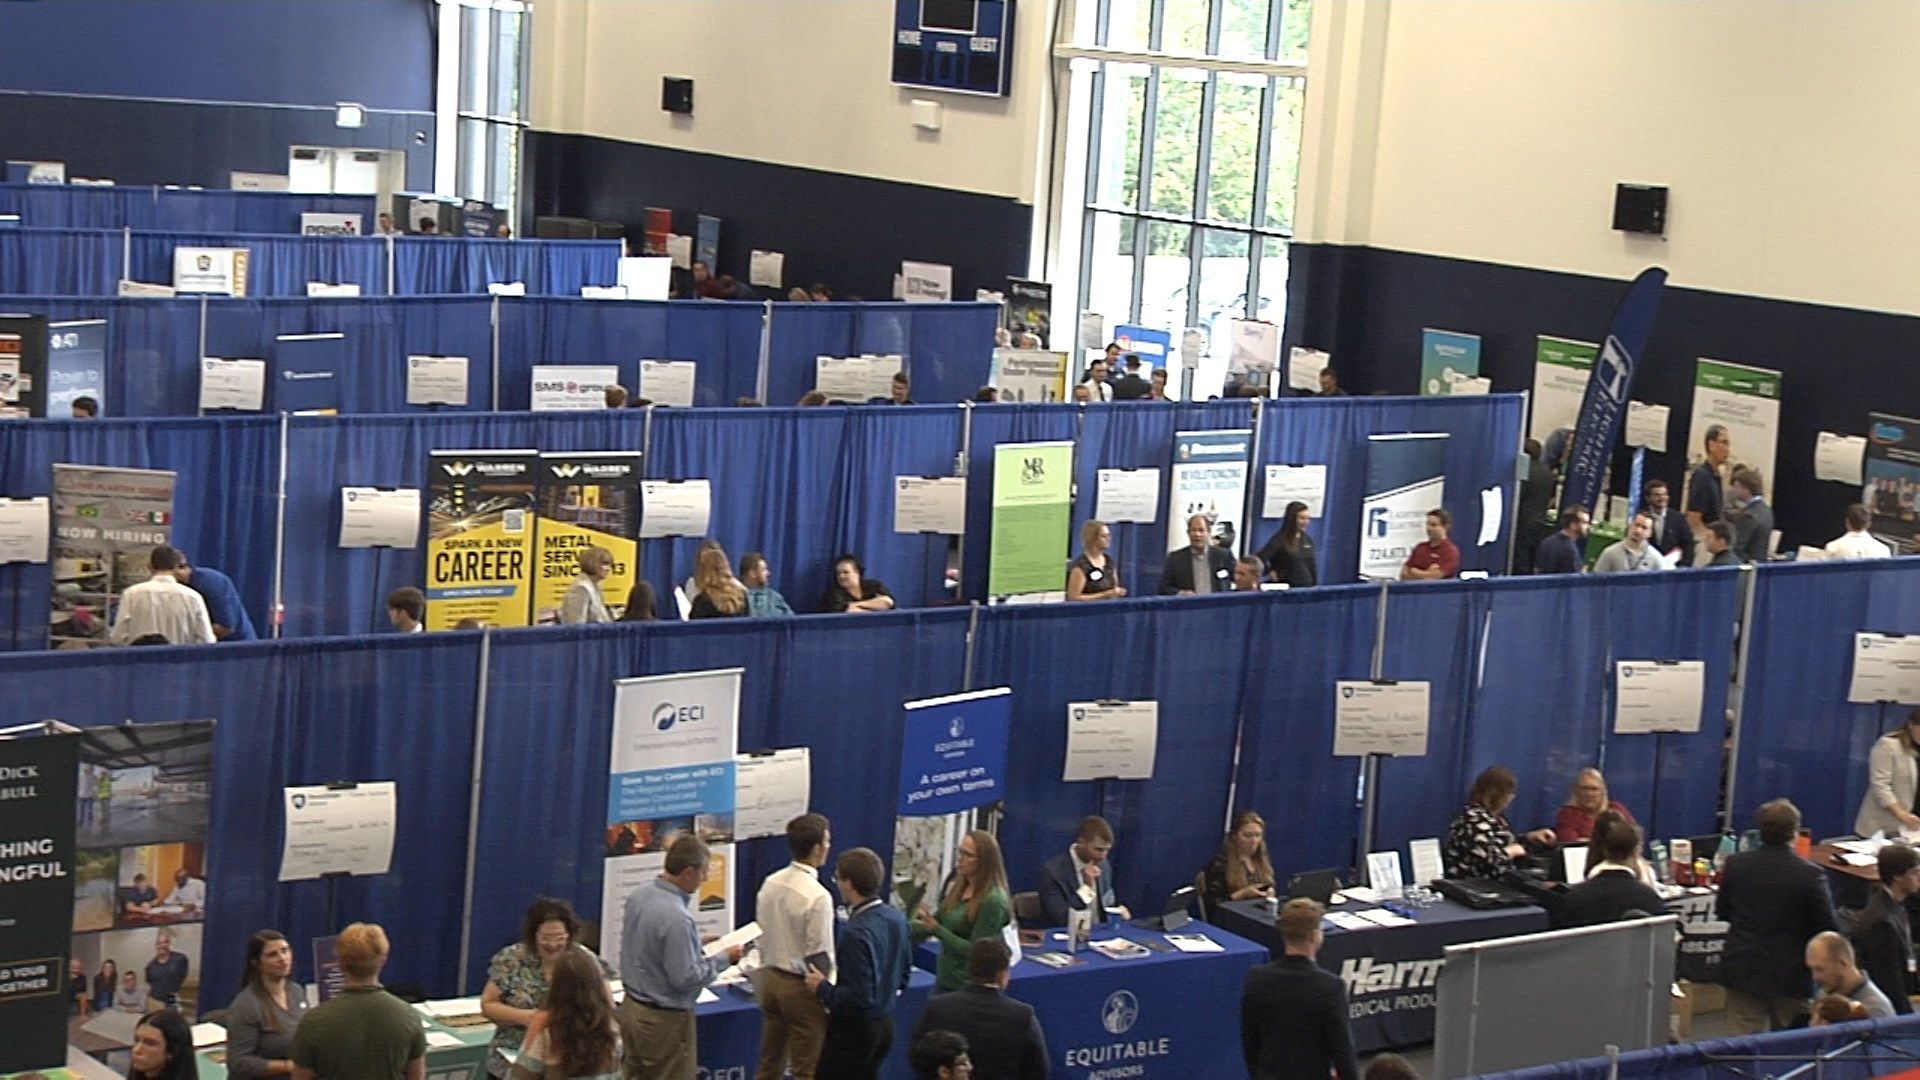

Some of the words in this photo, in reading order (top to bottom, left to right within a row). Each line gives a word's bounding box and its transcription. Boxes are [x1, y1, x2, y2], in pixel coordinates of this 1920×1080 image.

[535, 381, 564, 392] SMS
[57, 527, 98, 540] NOW
[102, 528, 166, 545] HIRING
[444, 540, 481, 551] SPARK
[485, 540, 494, 549] A
[496, 539, 524, 549] NEW
[544, 535, 594, 549] METAL
[434, 550, 524, 583] CAREER
[543, 551, 581, 565] SERV
[542, 564, 581, 579] SINC
[678, 705, 706, 723] ECI
[920, 773, 931, 785] A
[931, 770, 969, 783] career
[969, 767, 986, 777] on
[0, 786, 36, 799] BULL
[906, 789, 935, 805] your
[935, 784, 961, 796] own
[962, 779, 996, 792] terms
[0, 839, 54, 858] HING
[0, 862, 68, 882] NGFUL
[1341, 957, 1446, 996] Harm
[1348, 998, 1392, 1019] EDICAL
[1394, 993, 1436, 1010] PRODU
[1065, 1037, 1170, 1067] EQUITABLE
